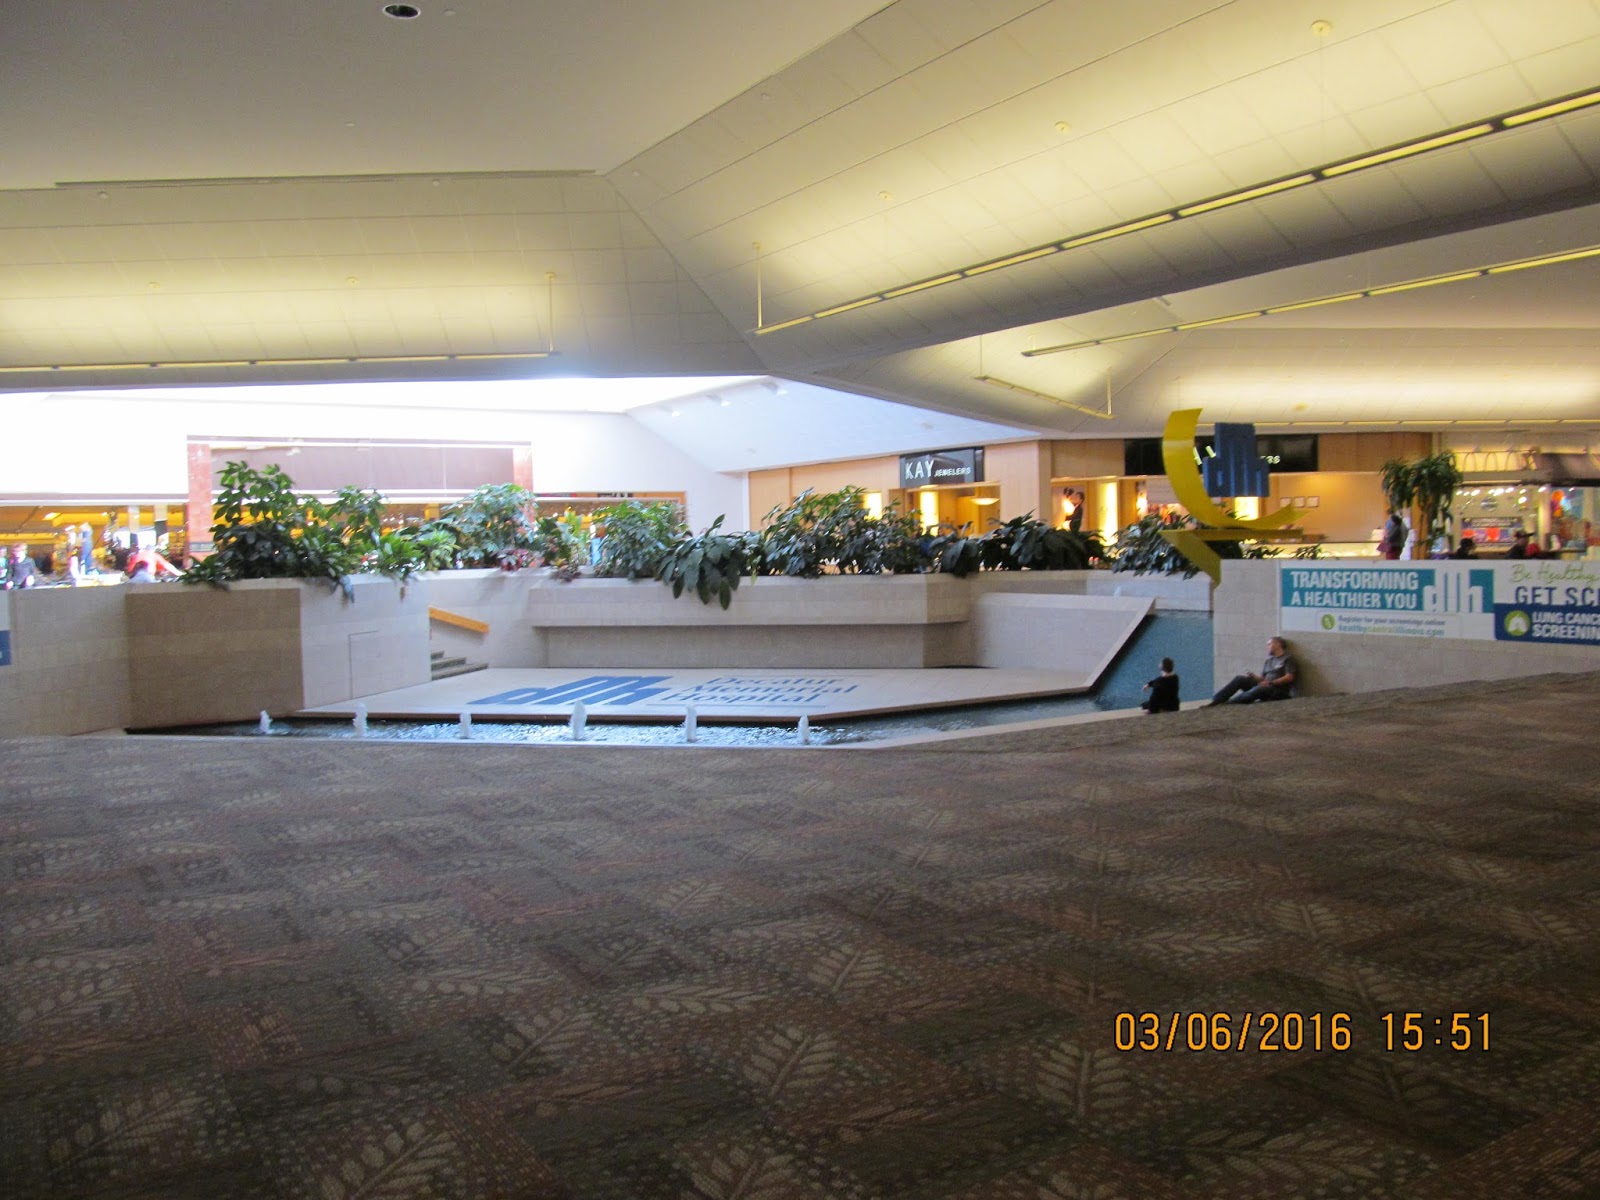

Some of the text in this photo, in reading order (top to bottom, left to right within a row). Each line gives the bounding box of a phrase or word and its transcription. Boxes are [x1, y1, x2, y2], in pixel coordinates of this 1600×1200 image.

[905, 460, 972, 480] KAY JEWELERS
[1290, 570, 1419, 590] TRANSFORMING
[1290, 591, 1417, 609] A HEALTHIER YOU
[1515, 585, 1600, 607] GET SC
[1531, 611, 1564, 624] LUNG
[660, 692, 821, 703] Hospital
[683, 684, 859, 693] Memorial
